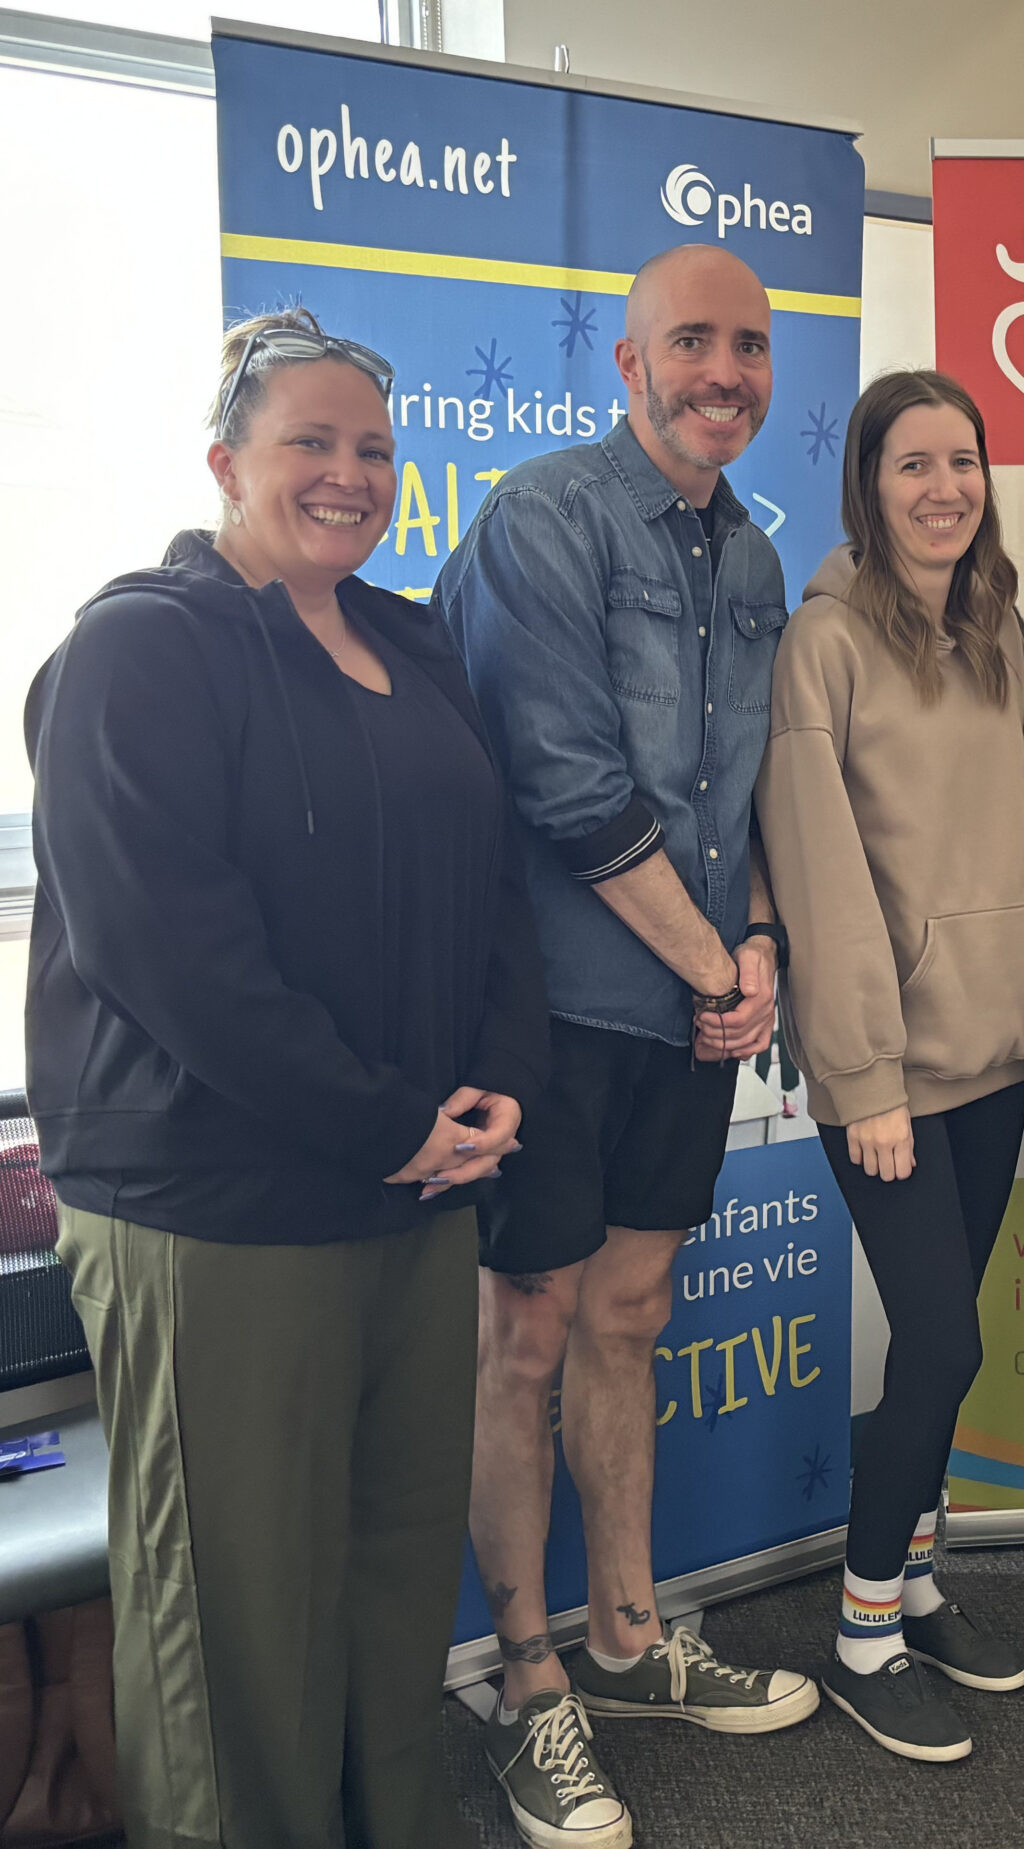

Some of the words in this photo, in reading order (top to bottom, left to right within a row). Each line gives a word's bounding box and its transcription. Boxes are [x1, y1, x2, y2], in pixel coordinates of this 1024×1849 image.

[276, 104, 518, 211] ophea.net
[507, 387, 597, 438] kids
[683, 1261, 754, 1302] une
[763, 1242, 819, 1283] vie
